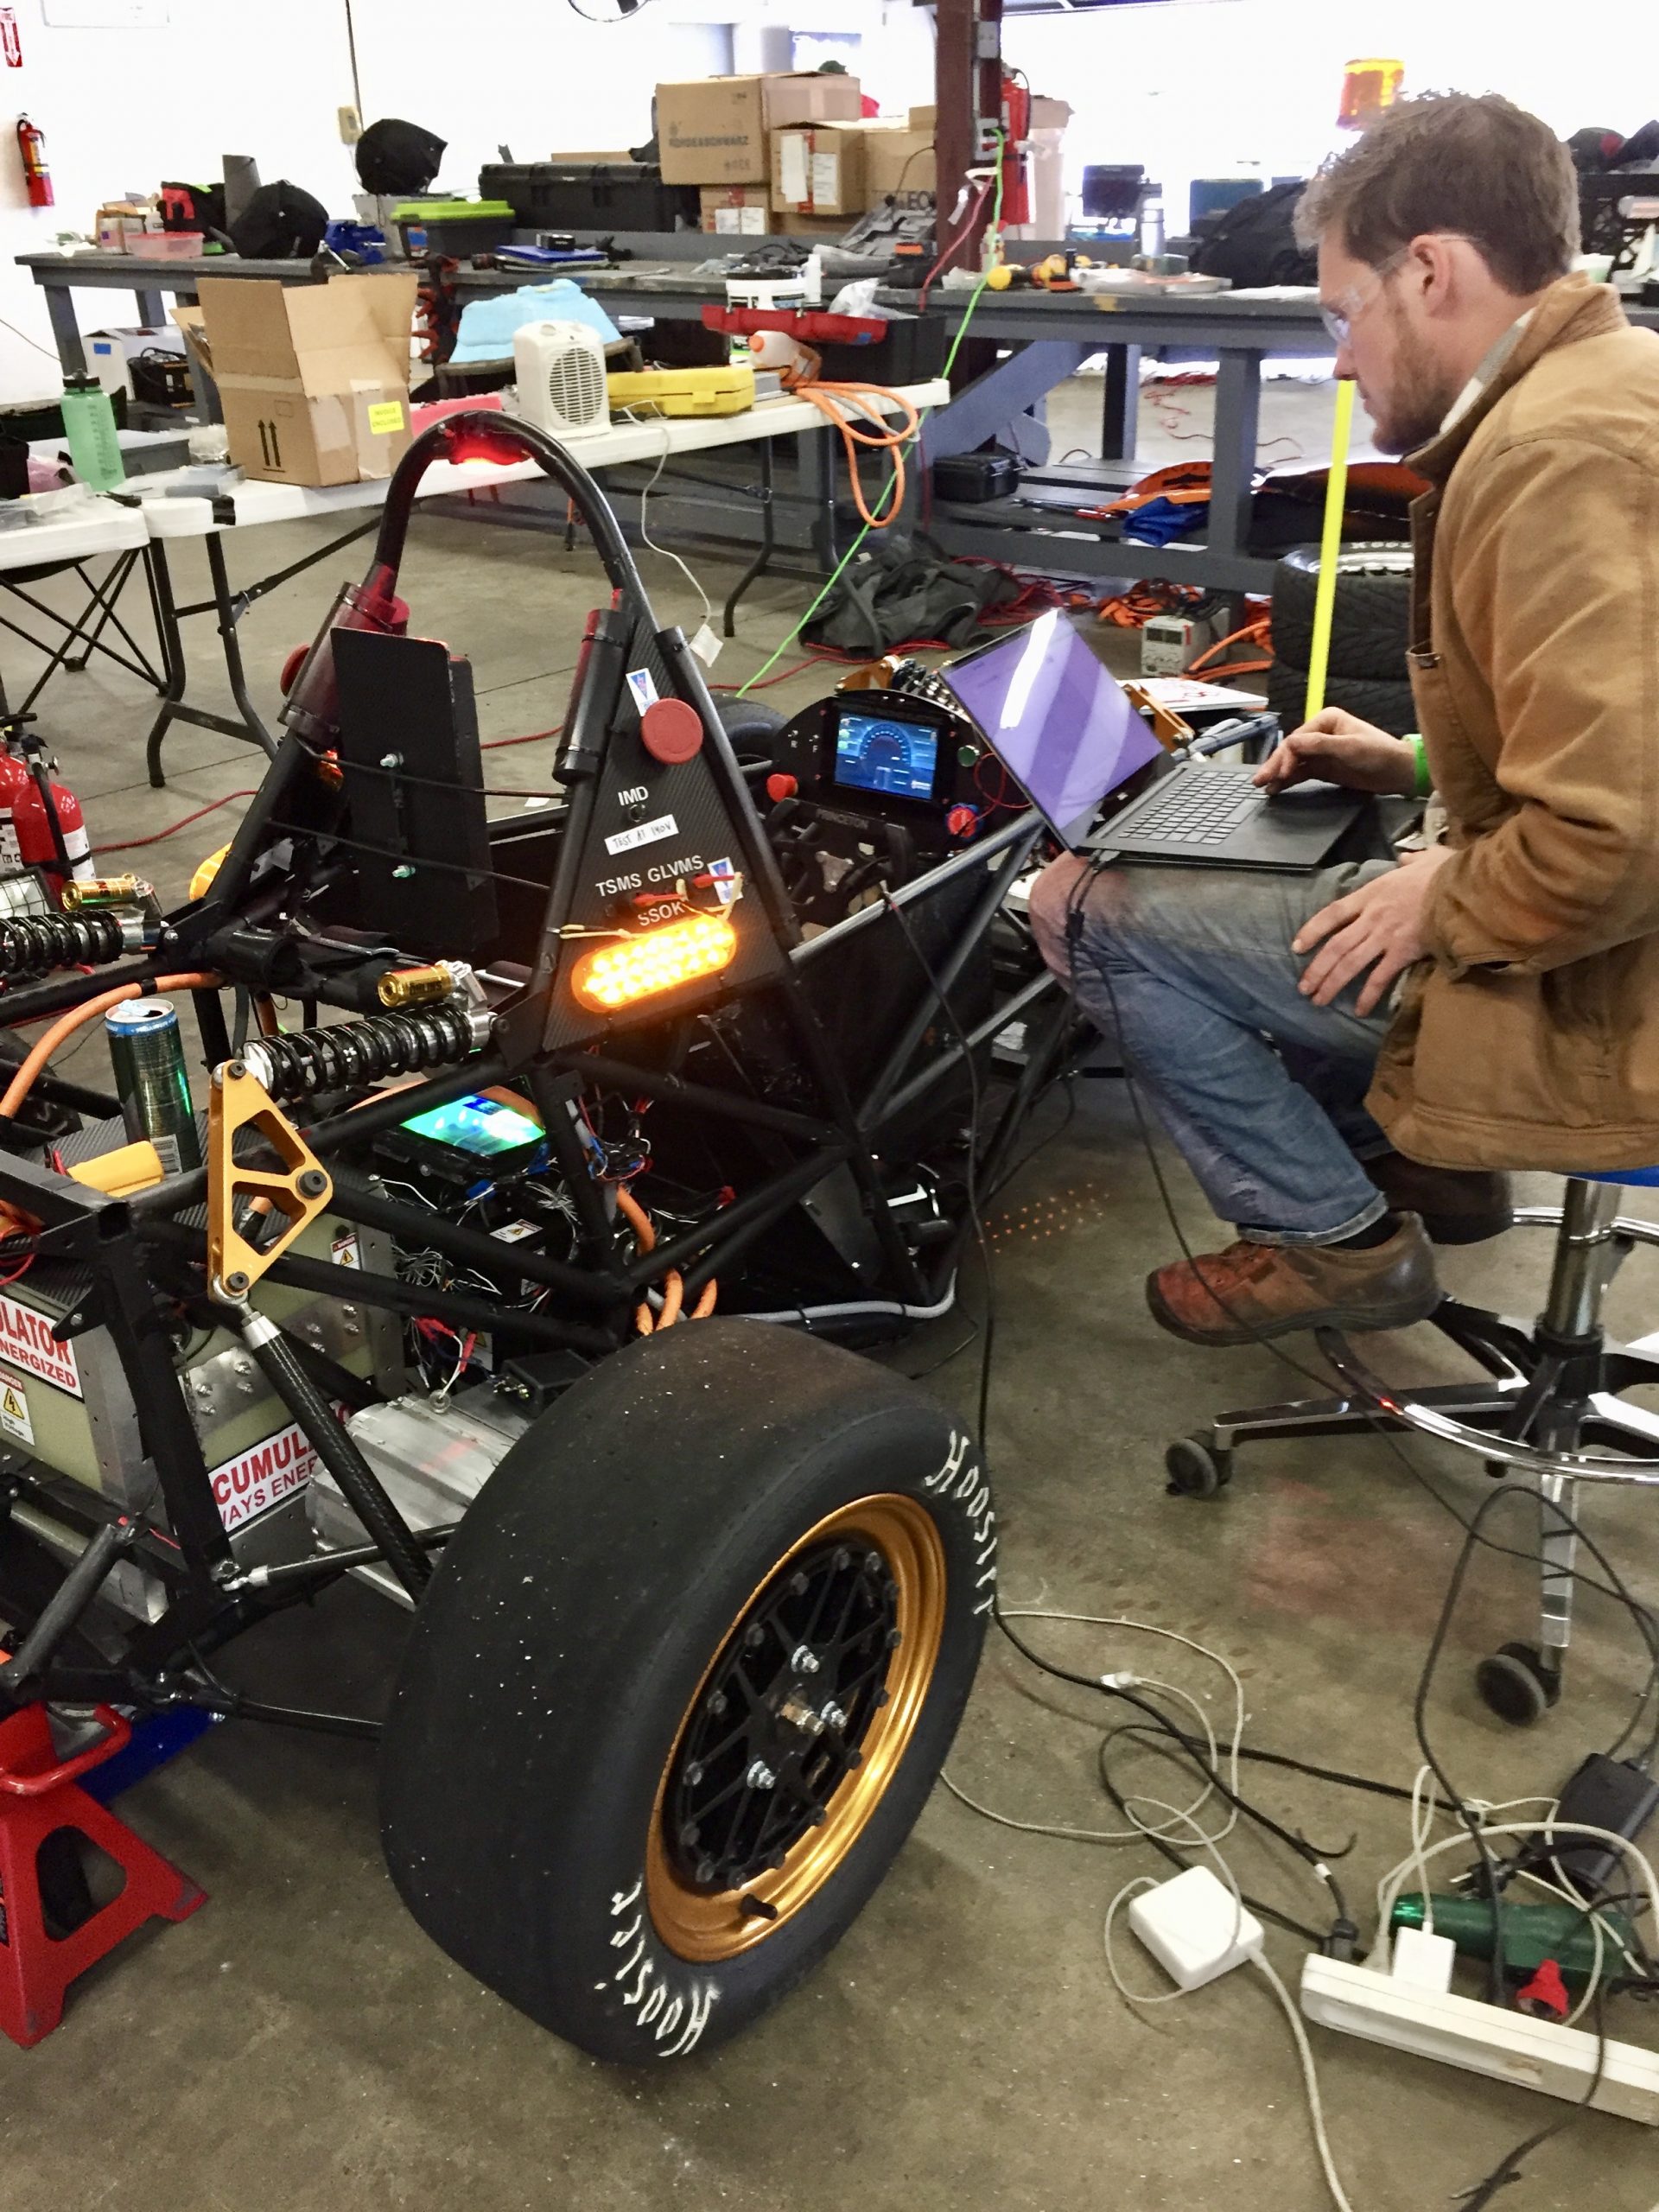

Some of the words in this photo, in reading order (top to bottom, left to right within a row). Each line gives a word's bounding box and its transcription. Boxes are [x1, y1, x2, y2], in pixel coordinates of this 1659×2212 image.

[618, 786, 649, 806] IMD
[612, 834, 632, 848] TEST
[637, 830, 646, 842] AT
[595, 873, 642, 897] TSMS
[647, 855, 704, 882] GLVMS
[638, 901, 685, 926] SSOK
[213, 1431, 314, 1505] CUMUL
